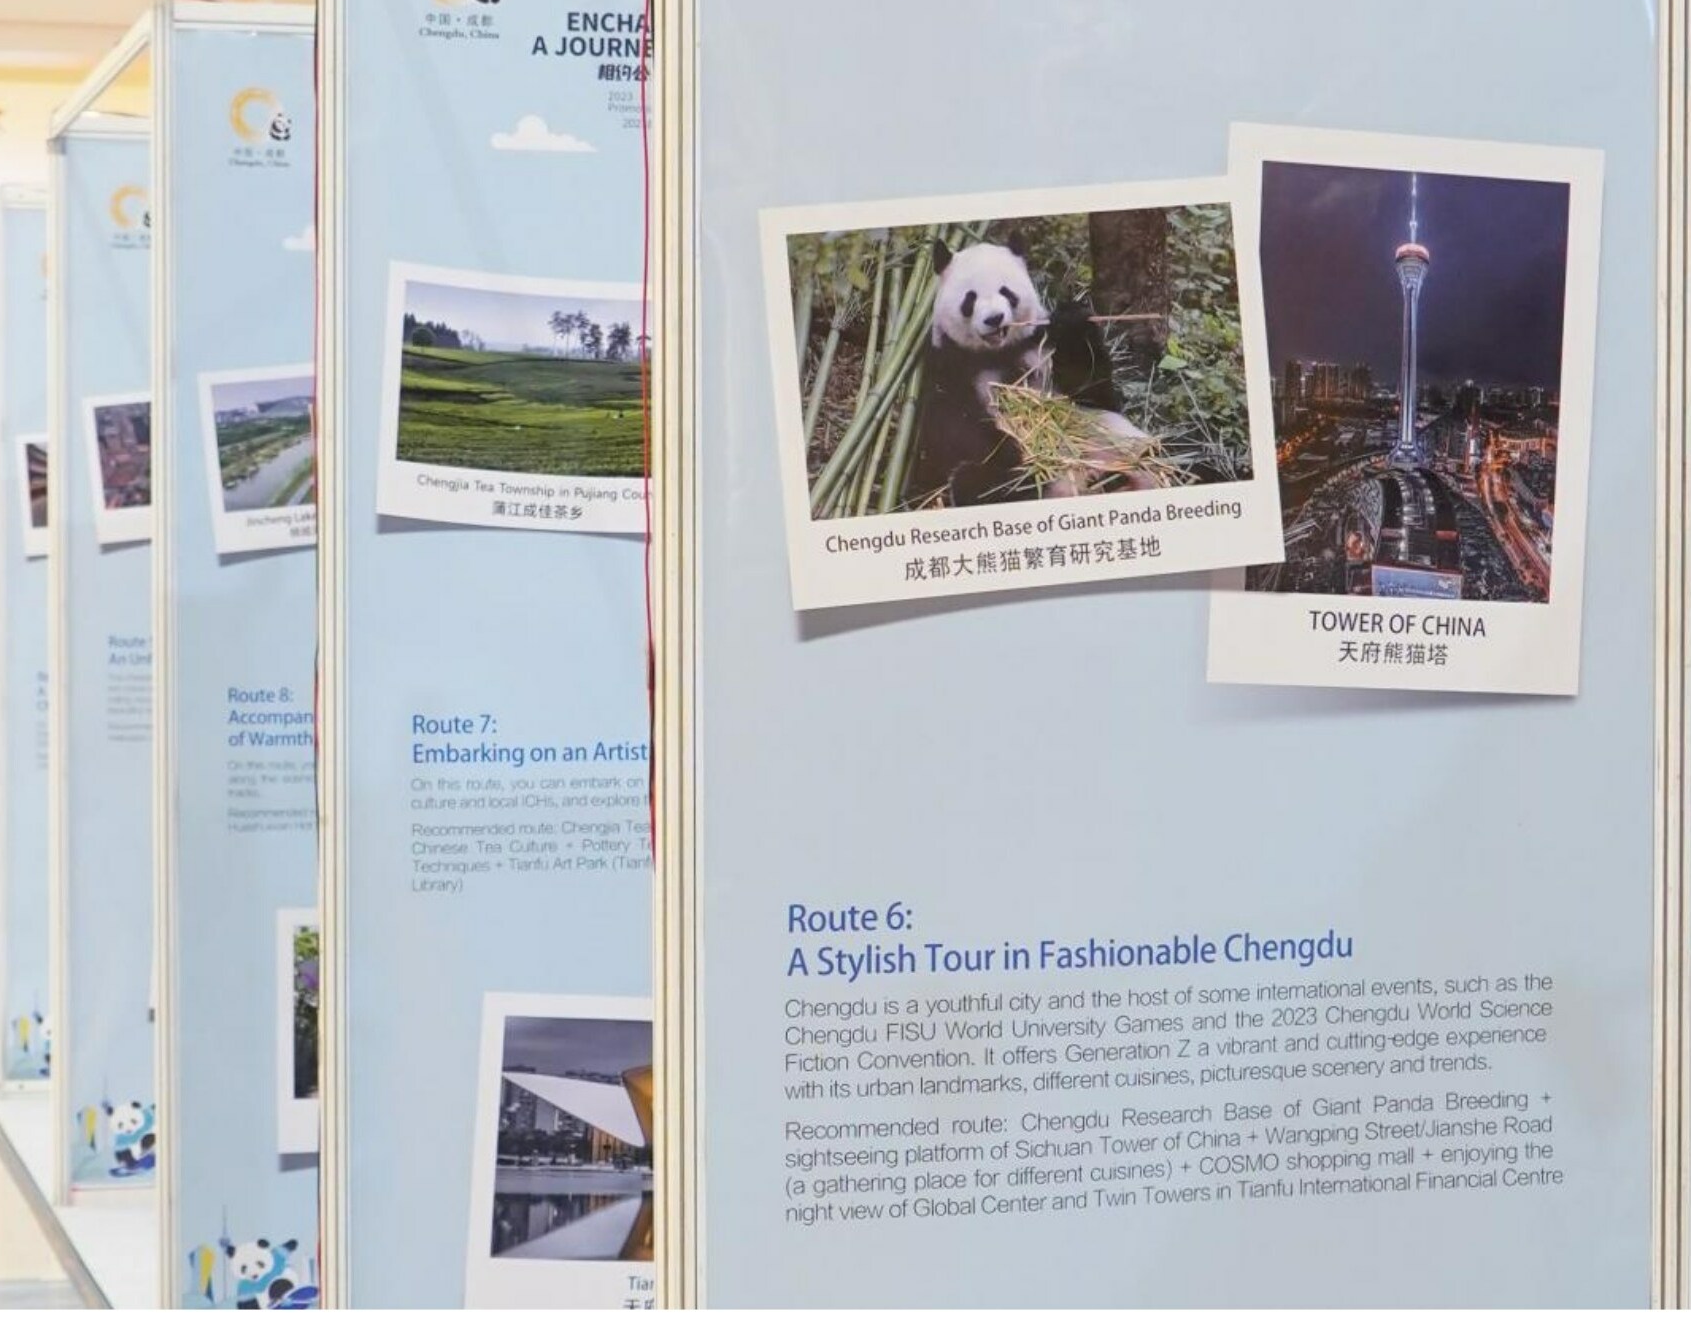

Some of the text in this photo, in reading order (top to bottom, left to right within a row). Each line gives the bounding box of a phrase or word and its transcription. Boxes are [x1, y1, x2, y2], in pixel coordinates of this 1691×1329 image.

[532, 36, 549, 56] A
[474, 480, 494, 493] Tea
[500, 482, 555, 498] Township
[559, 486, 570, 497] in
[574, 487, 618, 502] Pujiang
[825, 500, 1242, 554] Chengdu Research Base of Giant Panda Breeding
[904, 534, 1162, 582] 成都大熊猫繁育研究基地
[1309, 610, 1486, 638] TOWER OF CHINA
[1338, 640, 1449, 666] 天府熊猫塔
[228, 687, 294, 703] Route 8:
[228, 731, 246, 746] of
[412, 714, 498, 735] Route 7:
[412, 742, 524, 768] Embarking
[530, 746, 556, 762] on
[562, 745, 588, 762] an
[411, 822, 516, 836] Recommended
[788, 900, 913, 934] Route 6:
[788, 929, 1354, 983] A Stylish Tour in Fashionable Chengdu
[785, 972, 1553, 1020] Chengdu is a youthful city and the host of some international events, such as the
[785, 999, 1552, 1048] Chengdu FISU World University Games and the 2023 Chengdu World Science
[785, 1027, 1547, 1072] Fiction Convention. It offers Generation Z a vibrant and cutting-edge experience
[784, 1054, 1492, 1100] with its urban landmarks, different cuisines, picturesque scenery and trends.
